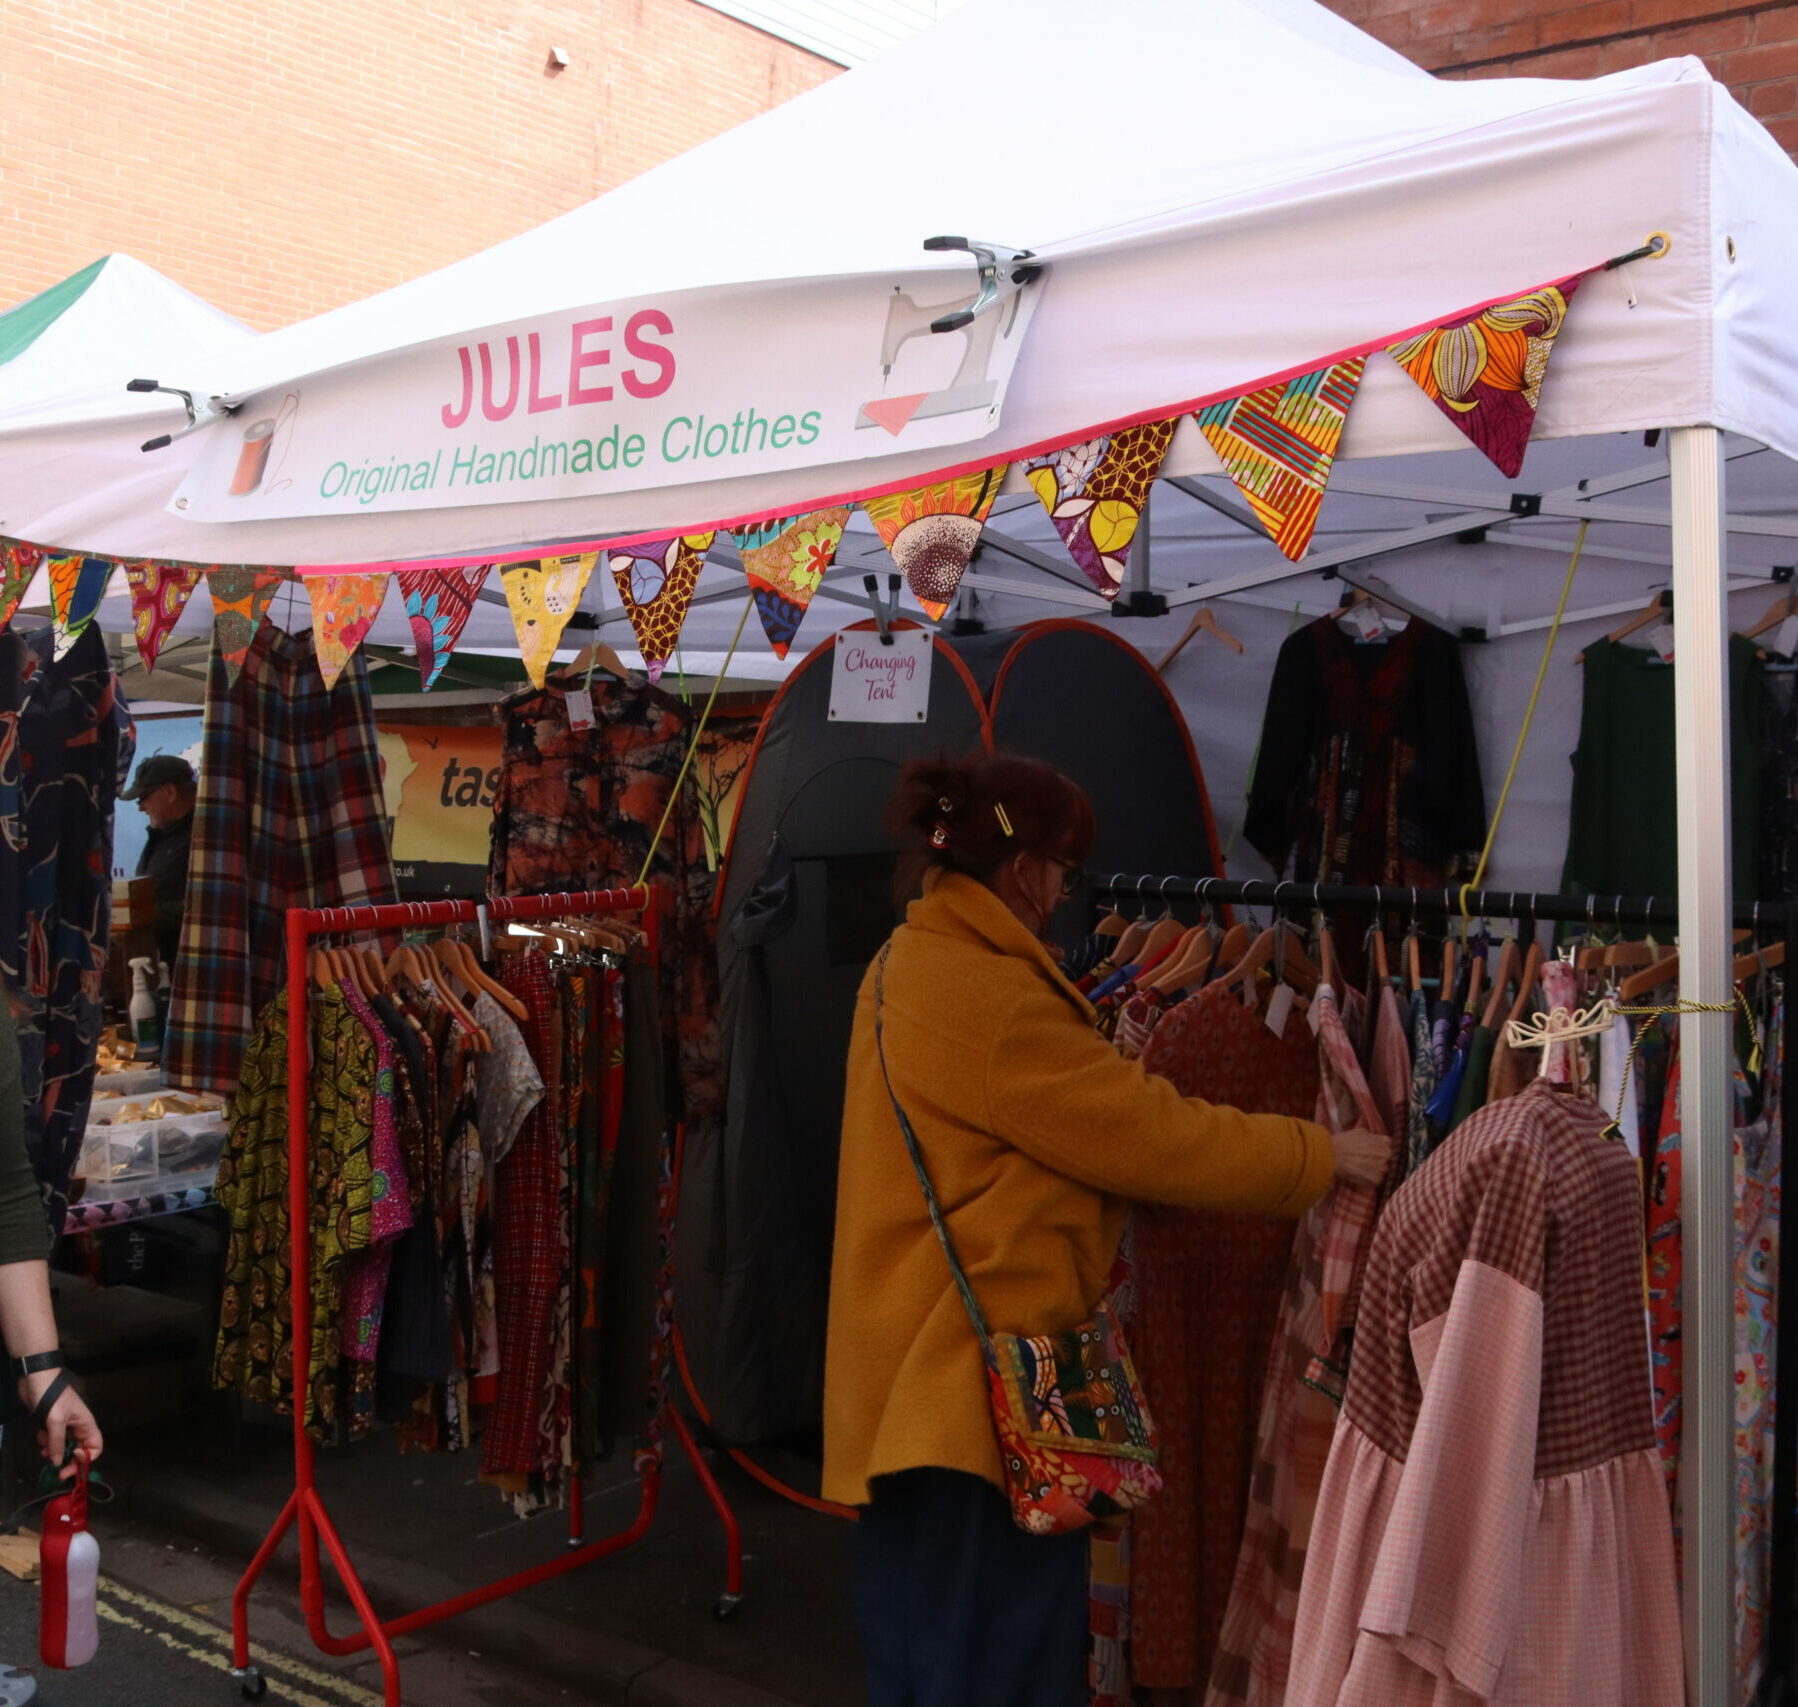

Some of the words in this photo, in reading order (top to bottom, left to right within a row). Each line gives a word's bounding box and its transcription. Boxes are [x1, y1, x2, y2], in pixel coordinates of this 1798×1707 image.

[441, 308, 677, 429] JULES
[319, 449, 443, 505] Original
[448, 423, 646, 487] Handmade
[661, 407, 822, 463] Clothes
[845, 648, 916, 682] Changing
[865, 678, 898, 702] Tent
[393, 865, 415, 878] o.uk
